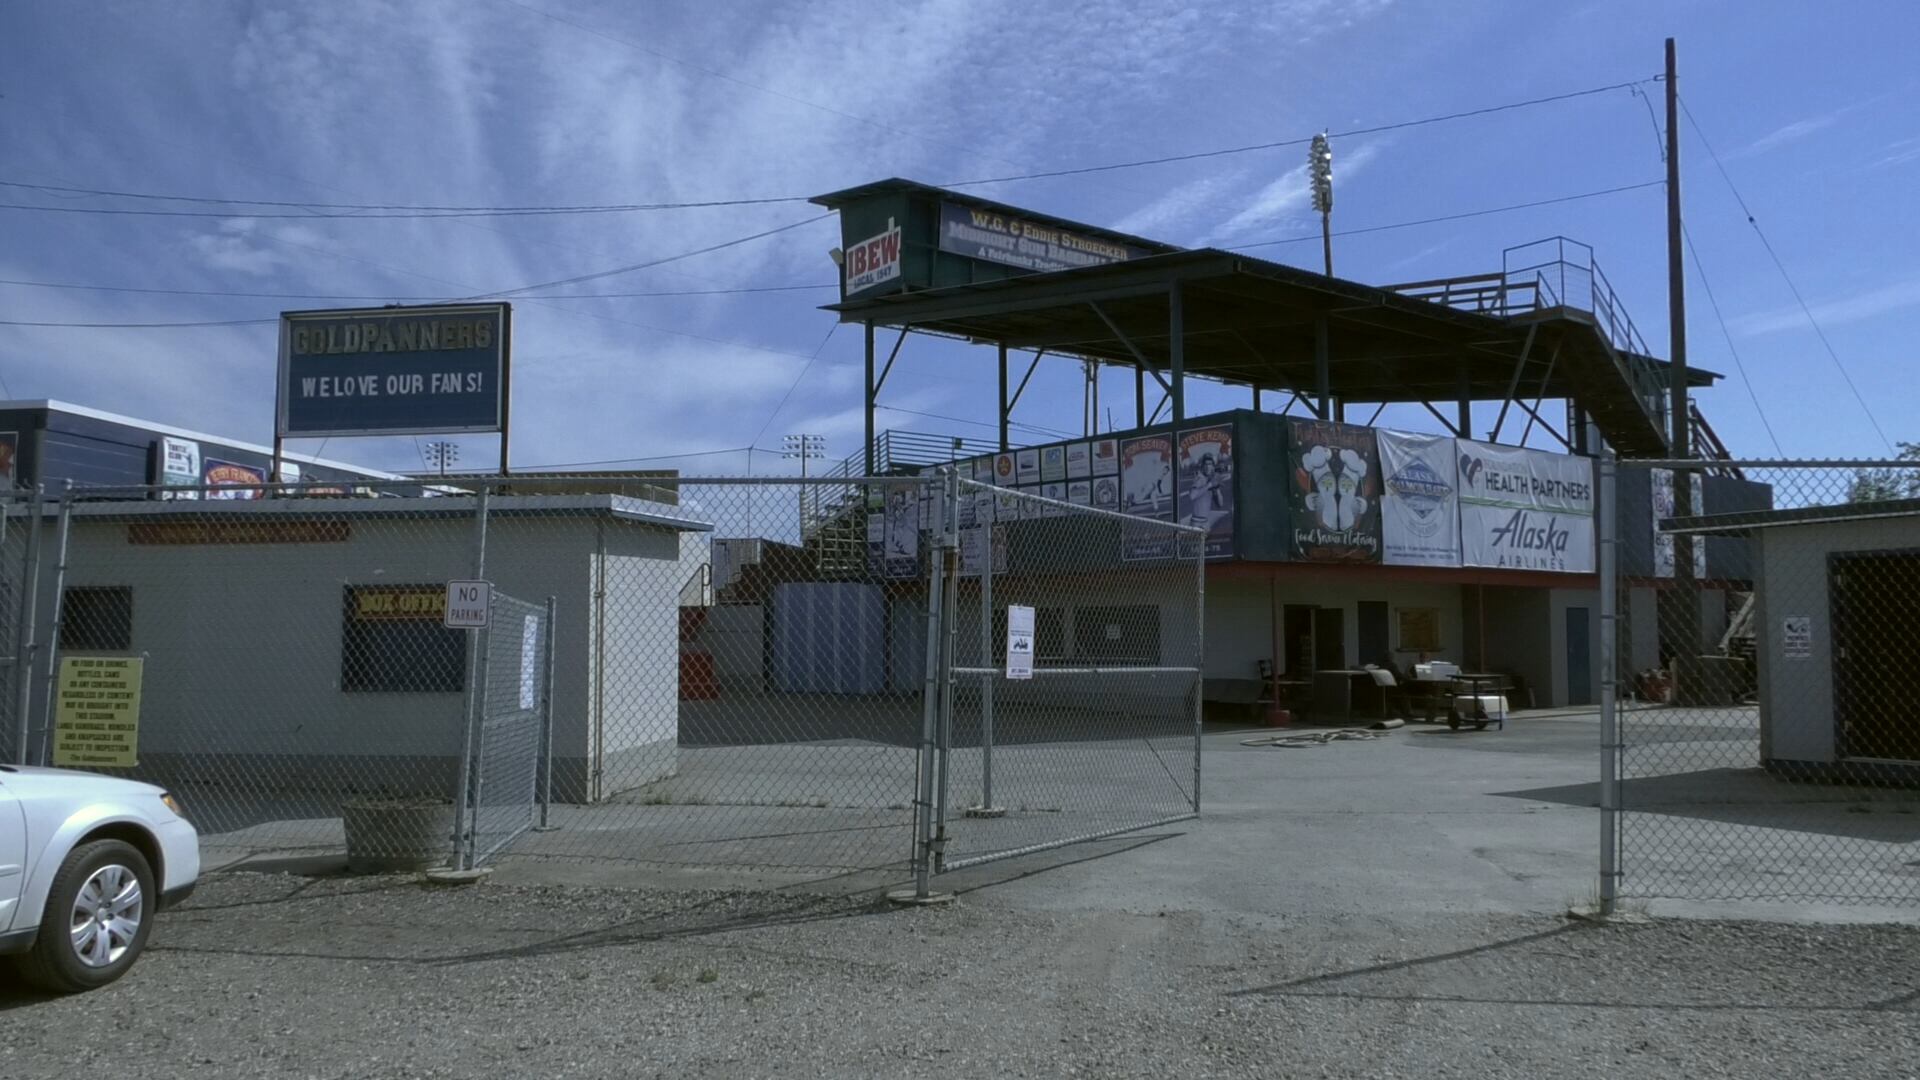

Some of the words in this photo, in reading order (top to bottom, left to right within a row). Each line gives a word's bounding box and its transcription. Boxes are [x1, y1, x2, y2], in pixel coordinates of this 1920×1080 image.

[848, 231, 900, 280] IBEW
[854, 274, 874, 289] LOCAL
[295, 319, 492, 355] GOLDPANNERS
[386, 374, 423, 394] OUR
[1485, 472, 1528, 494] HEALTH
[1531, 478, 1590, 501] PARTNERS
[1295, 528, 1314, 545] Food
[1491, 508, 1569, 557] Alaska
[1499, 555, 1565, 570] AIRLINES
[459, 587, 478, 602] NO
[451, 608, 484, 622] PARKING
